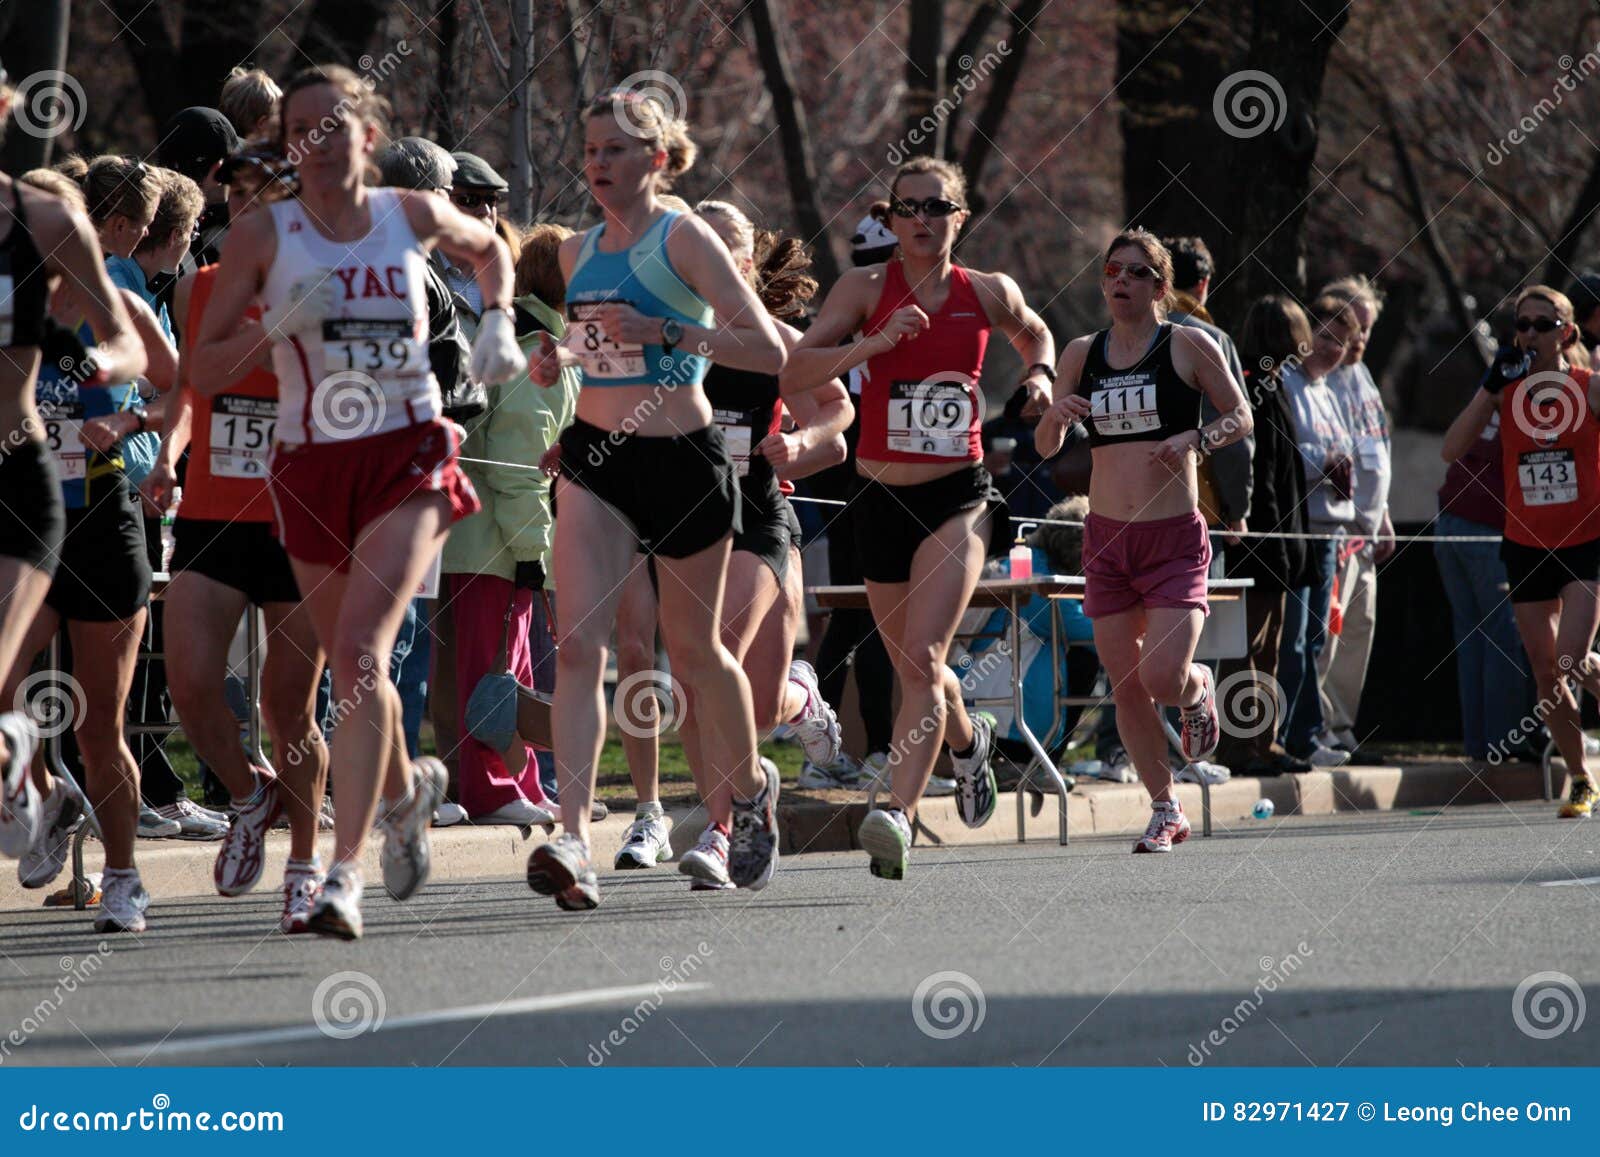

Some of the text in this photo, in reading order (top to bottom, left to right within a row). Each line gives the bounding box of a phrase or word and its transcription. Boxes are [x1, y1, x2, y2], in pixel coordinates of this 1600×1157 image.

[341, 339, 409, 370] 139
[900, 399, 961, 429] 109
[1100, 386, 1145, 414] 111
[1526, 463, 1569, 485] 143
